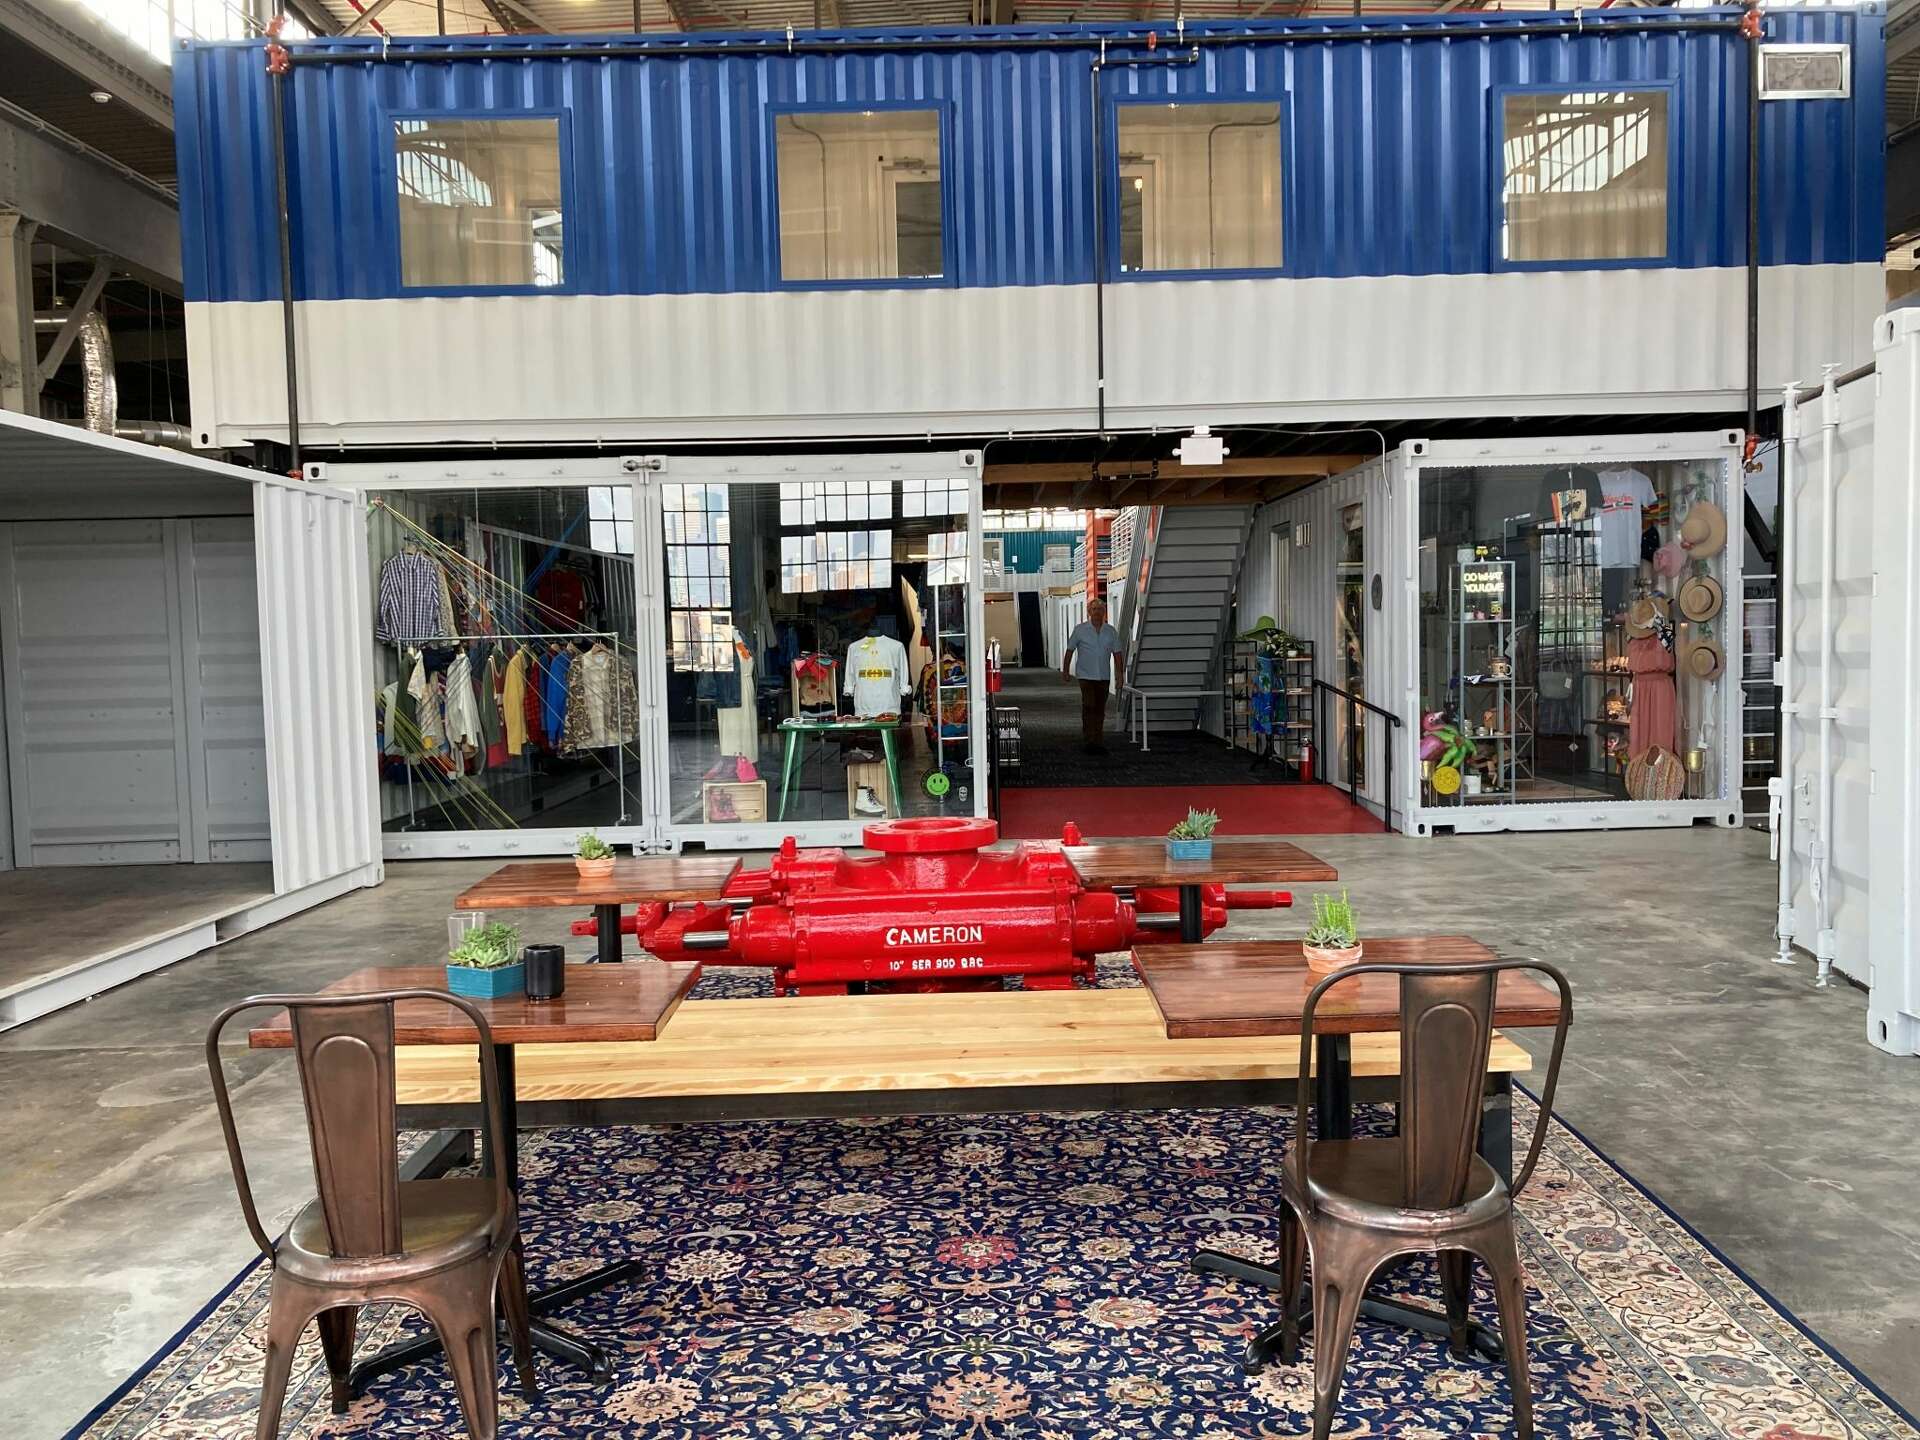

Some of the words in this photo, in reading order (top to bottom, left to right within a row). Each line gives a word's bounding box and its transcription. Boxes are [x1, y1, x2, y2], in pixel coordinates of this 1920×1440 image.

[1463, 572, 1478, 582] DO
[1478, 571, 1504, 581] WHAT
[1463, 583, 1481, 593] YOU
[1482, 582, 1504, 592] LOVE
[886, 926, 983, 945] CAMERON
